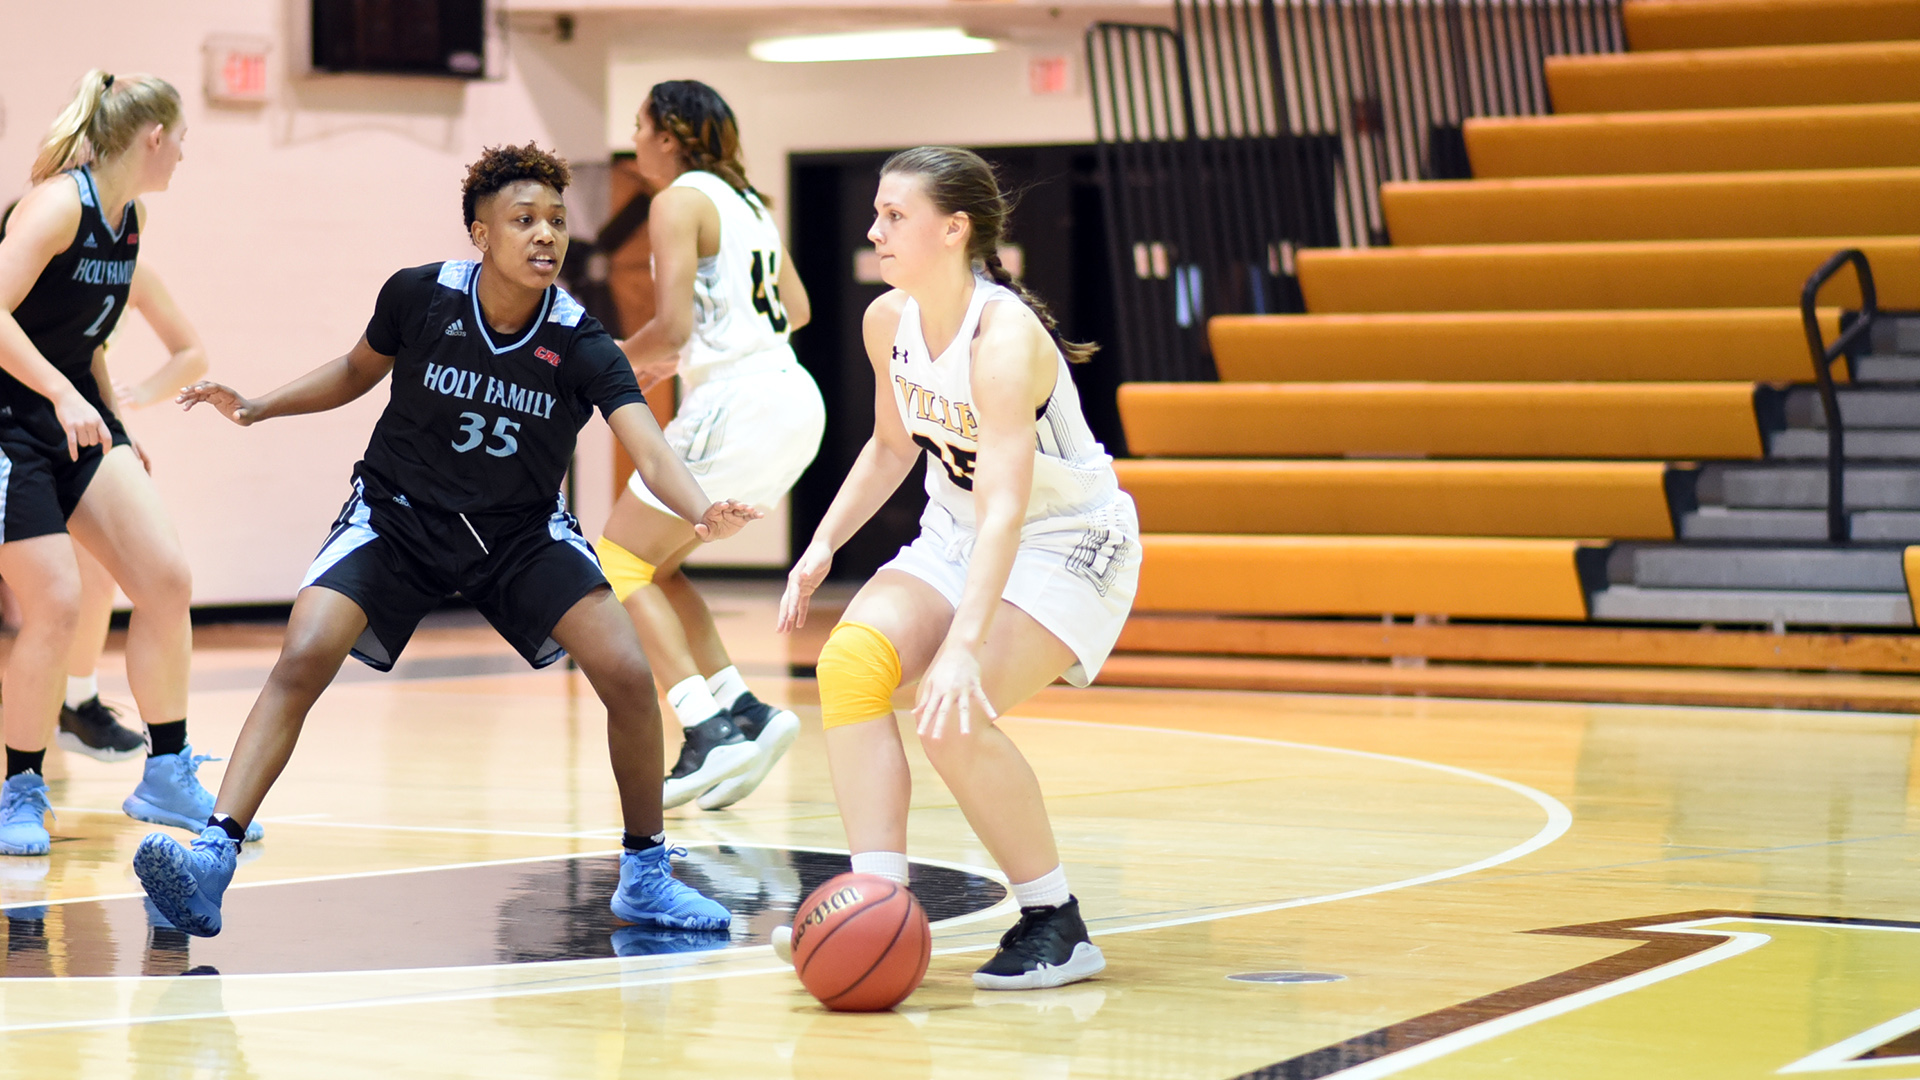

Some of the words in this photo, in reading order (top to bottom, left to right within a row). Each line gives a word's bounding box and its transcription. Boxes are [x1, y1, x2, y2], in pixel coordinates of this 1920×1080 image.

[83, 294, 116, 337] 2
[423, 362, 483, 400] HOLY
[483, 376, 557, 420] FAMILY
[895, 374, 978, 443] VILLE
[451, 411, 521, 458] 35
